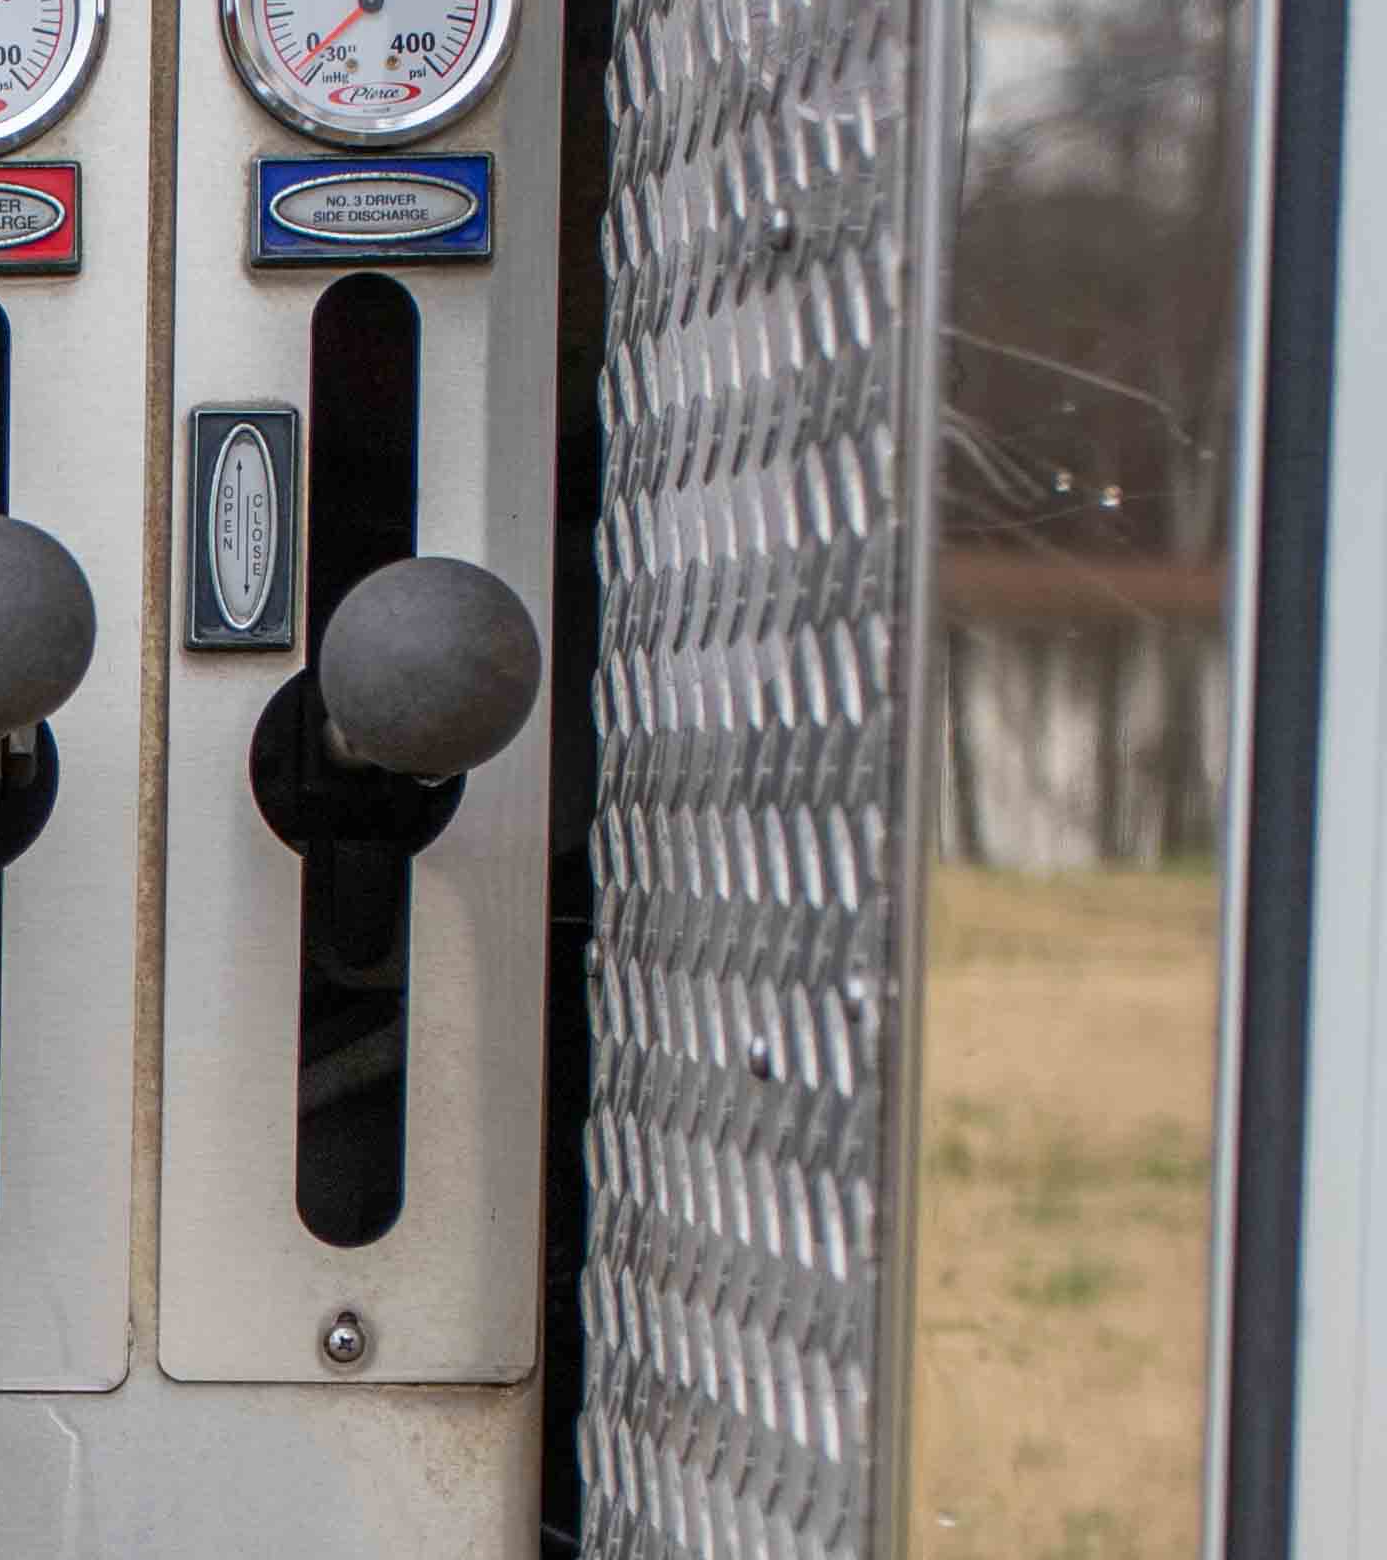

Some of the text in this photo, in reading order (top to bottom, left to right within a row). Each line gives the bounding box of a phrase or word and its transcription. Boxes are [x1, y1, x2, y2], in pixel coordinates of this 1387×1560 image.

[306, 33, 320, 51] 0
[390, 32, 435, 53] 400
[409, 67, 427, 80] psi
[350, 86, 399, 103] Pierce
[326, 194, 416, 208] NO. 3 DRIVER
[313, 209, 428, 223] SIDE DISCHARGE
[223, 486, 234, 551] OPEN
[251, 494, 263, 576] CLOSE
